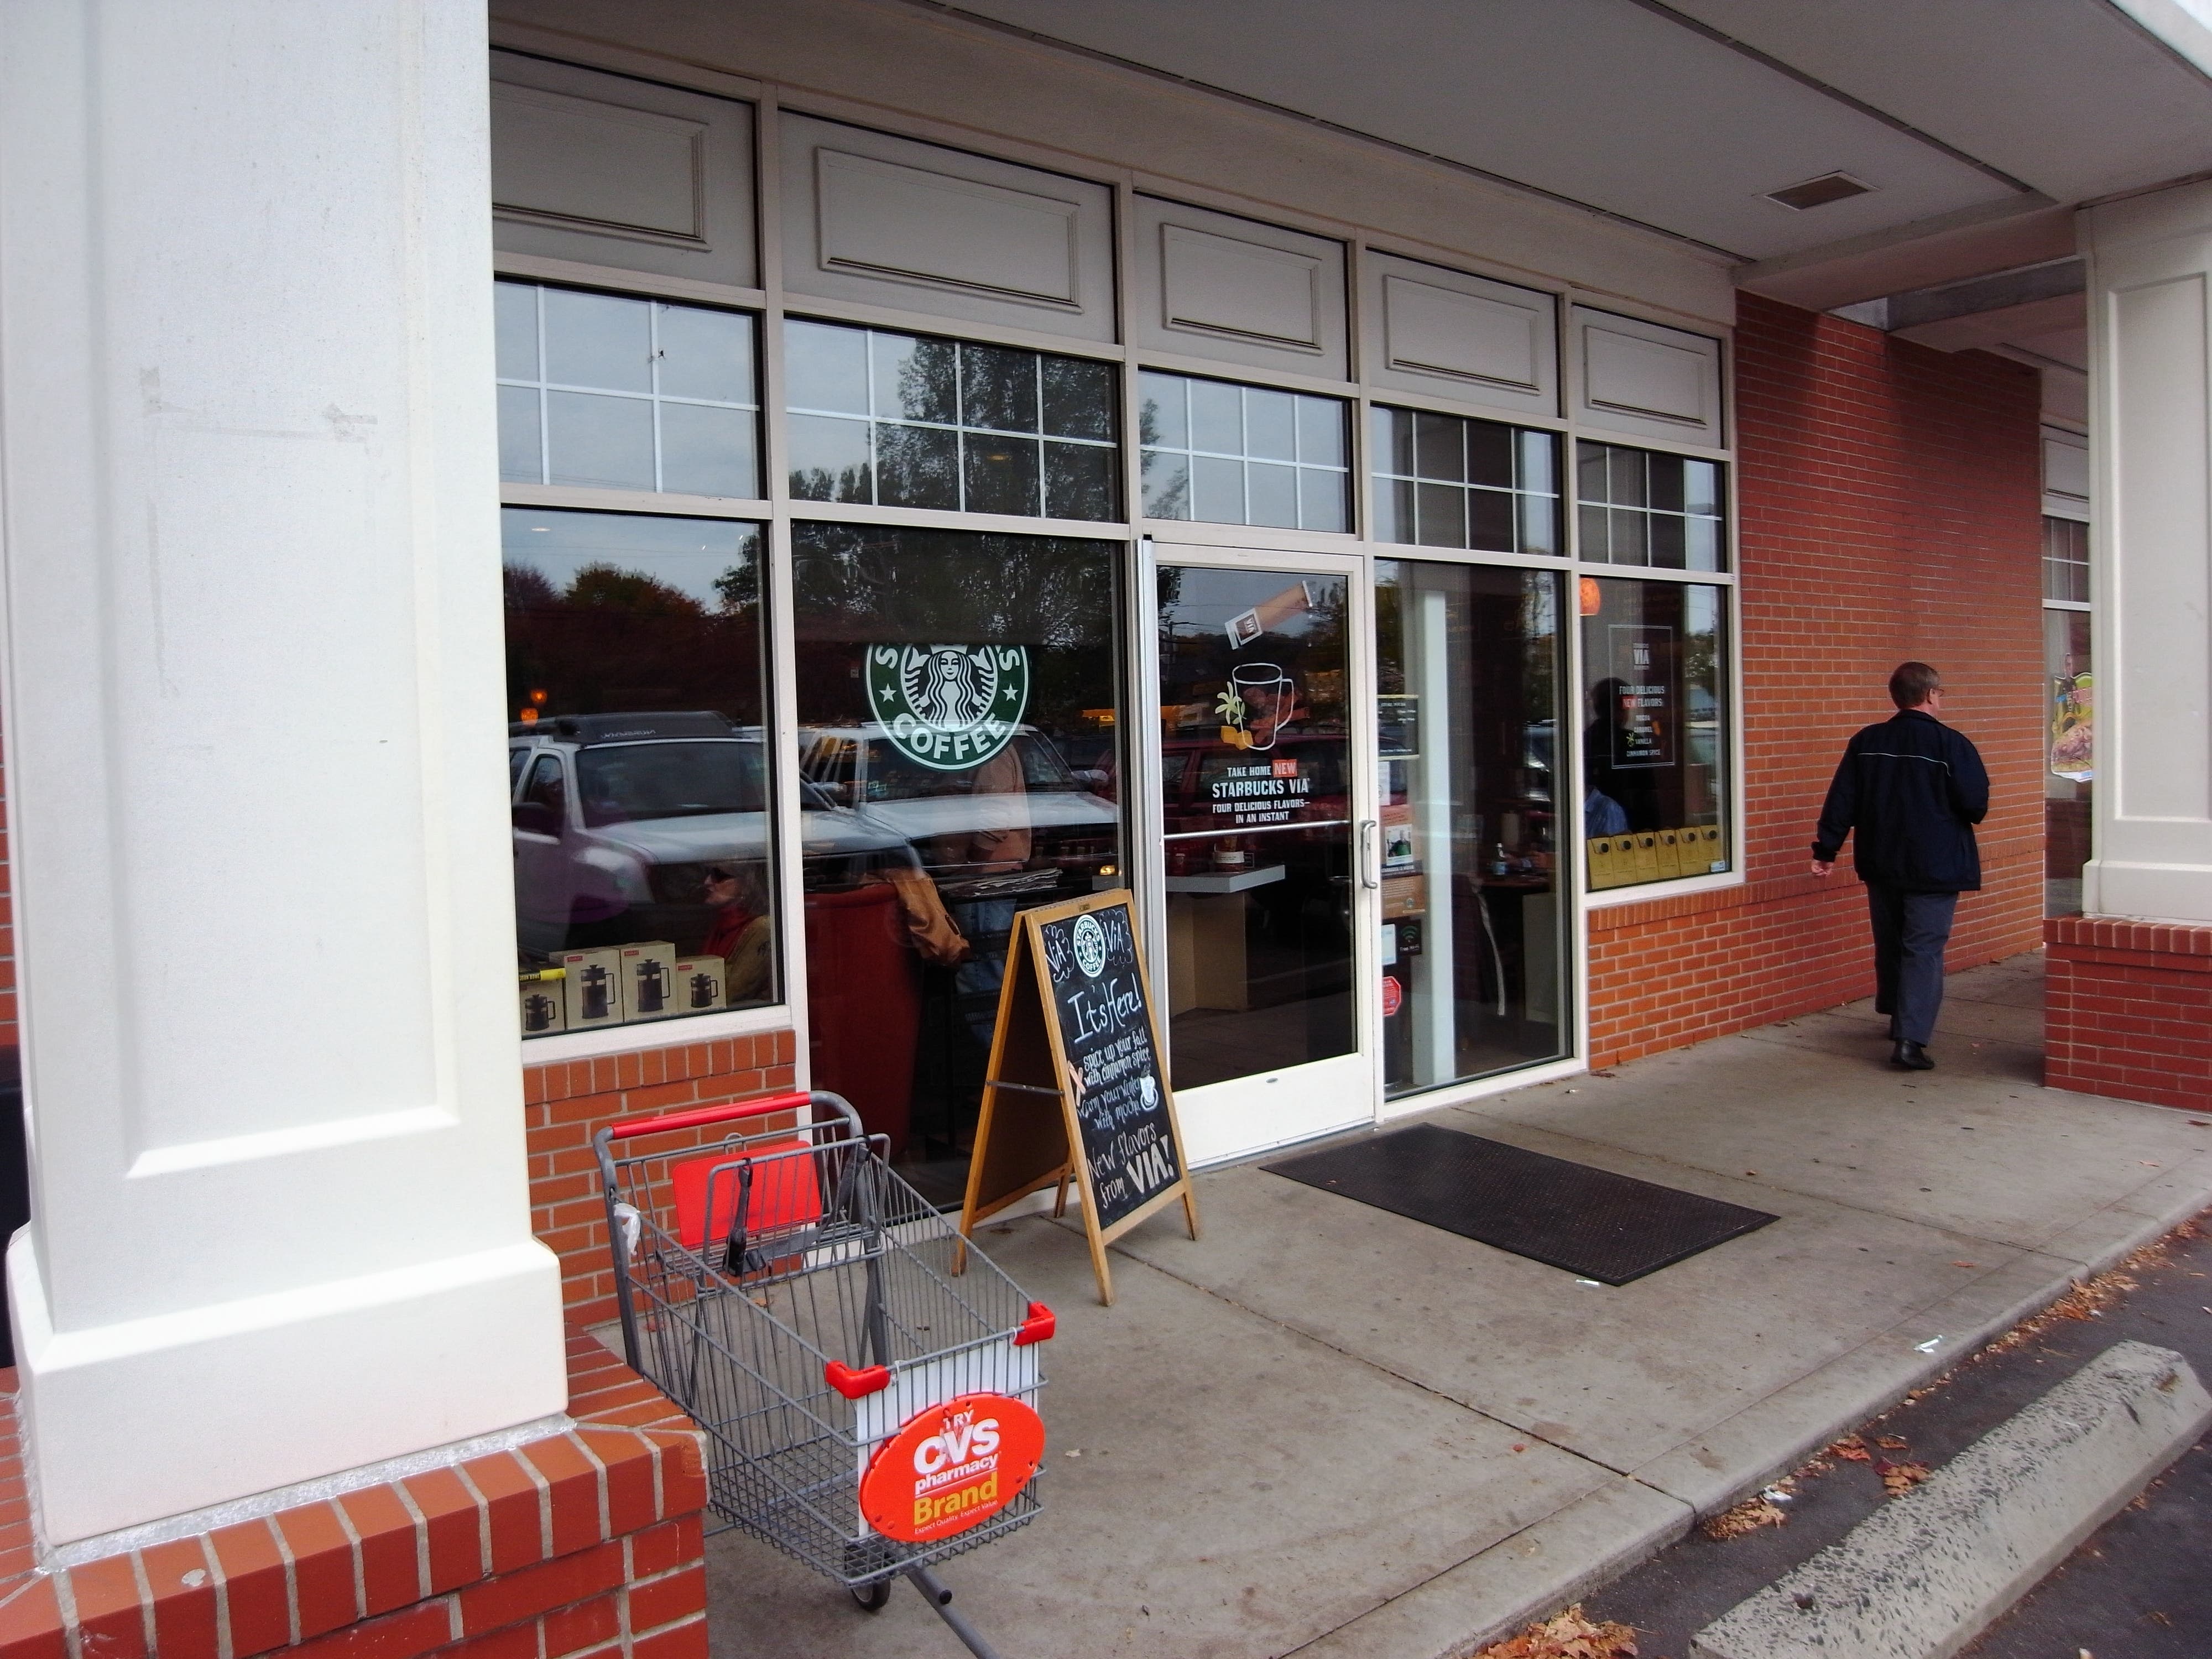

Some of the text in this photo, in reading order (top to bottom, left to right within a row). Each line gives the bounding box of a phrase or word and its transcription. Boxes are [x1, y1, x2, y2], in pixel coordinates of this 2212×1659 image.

[893, 712, 1007, 761] COFFEE
[1227, 762, 1297, 777] TAKE HOME NEW
[1212, 779, 1285, 799] STARBUCKS
[1212, 803, 1232, 813] FOUR
[1234, 800, 1271, 812] DELICIOUS
[1235, 811, 1290, 824] IN AN INSTANT
[1076, 921, 1100, 947] STARBUCKS
[1082, 955, 1102, 971] COFFEE
[1083, 1026, 1147, 1072] spice up your fall
[1083, 1046, 1151, 1087] with cinnamon spice
[1094, 1095, 1141, 1130] with mocha
[1100, 1089, 1120, 1113] your
[1117, 1121, 1157, 1165] flavors
[1099, 1134, 1175, 1209] from VIA!
[942, 1408, 974, 1430] TRY
[913, 1418, 1000, 1474] CVS
[915, 1453, 999, 1496] pharmacy
[914, 1471, 998, 1526] Brand
[914, 1521, 936, 1535] Expect
[936, 1514, 959, 1527] Quality
[960, 1505, 981, 1518] Expect
